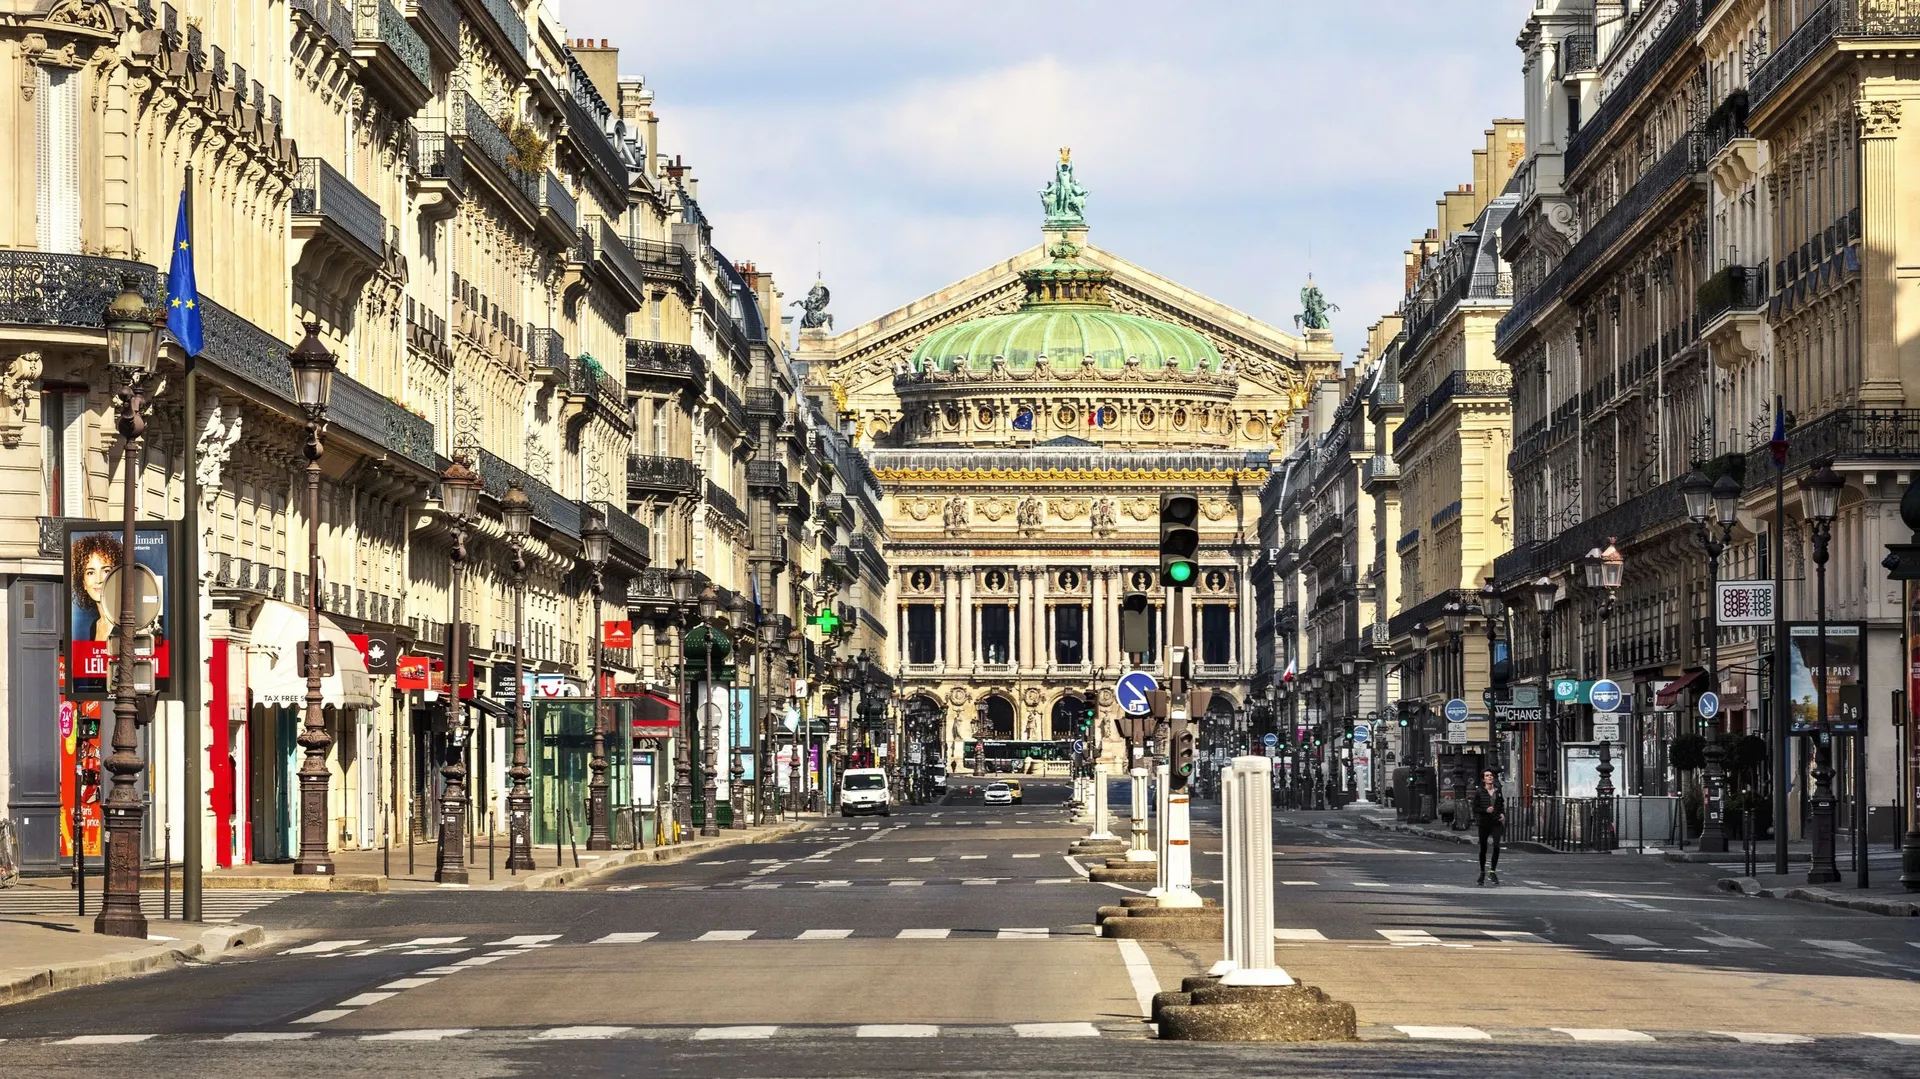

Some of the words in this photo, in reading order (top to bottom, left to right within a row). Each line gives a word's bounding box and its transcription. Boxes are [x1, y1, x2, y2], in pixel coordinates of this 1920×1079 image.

[120, 534, 164, 545] limard
[1723, 589, 1772, 597] COPY-TOP
[85, 654, 108, 674] LEÏL
[1811, 667, 1831, 676] PET
[1833, 666, 1851, 676] PAYS
[1507, 709, 1542, 720] CHANGE
